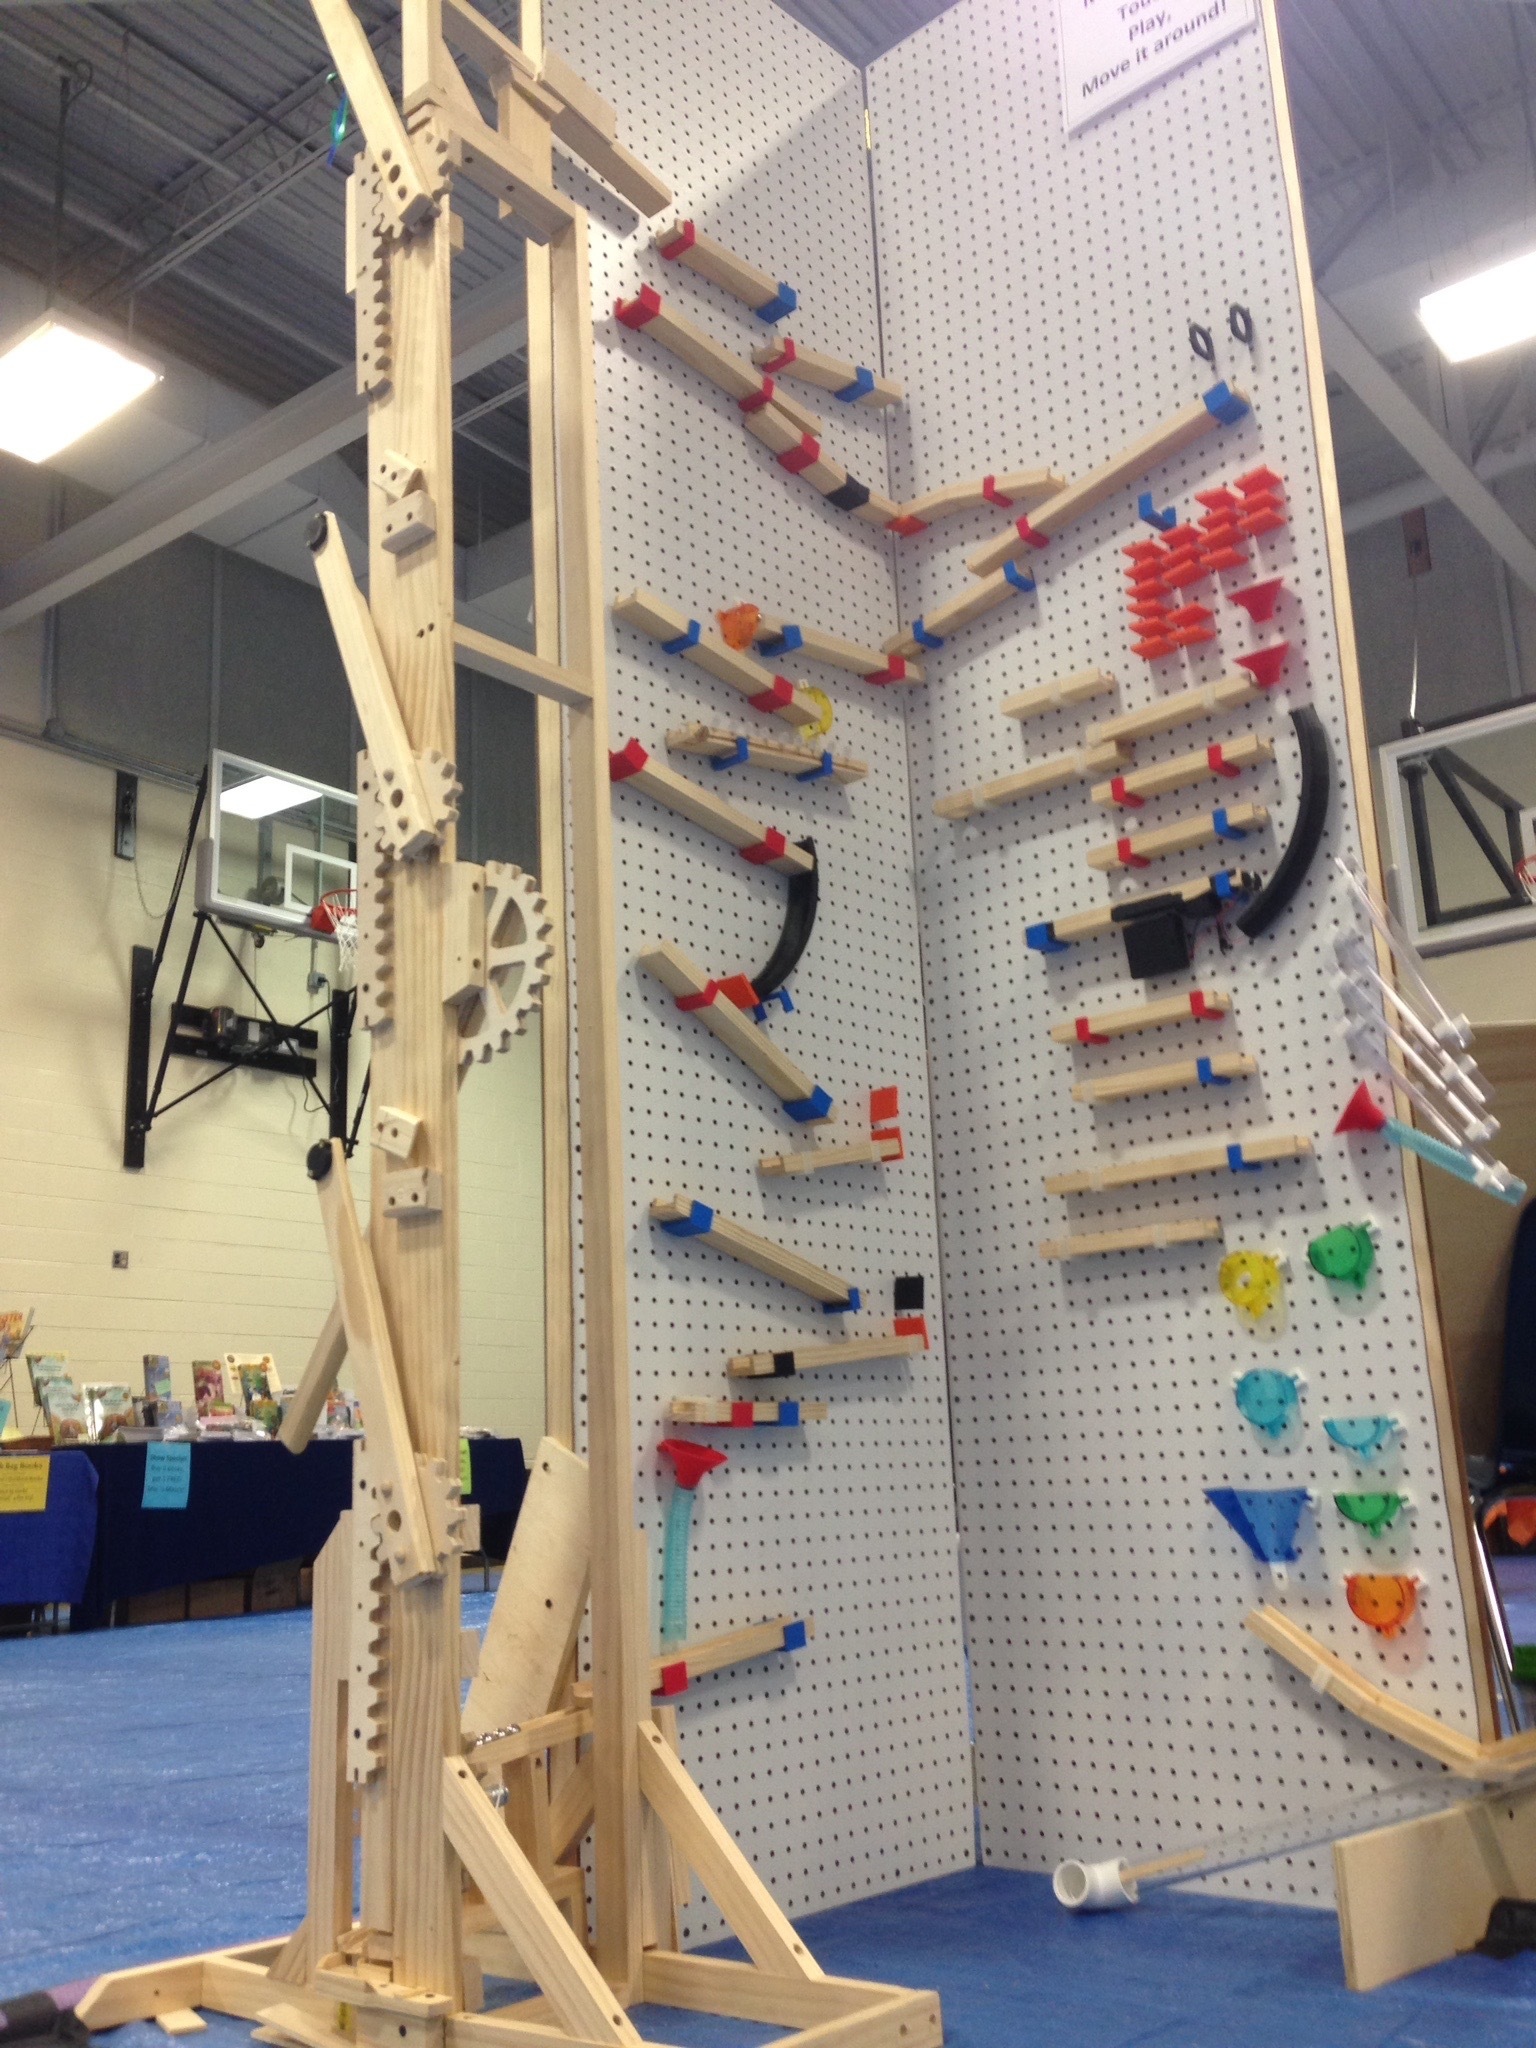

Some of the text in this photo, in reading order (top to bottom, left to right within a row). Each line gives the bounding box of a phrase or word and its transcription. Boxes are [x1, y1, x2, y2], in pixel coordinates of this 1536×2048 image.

[1117, 0, 1159, 20] Tou
[1128, 10, 1171, 41] Play,
[1082, 0, 1227, 98] Move it around!
